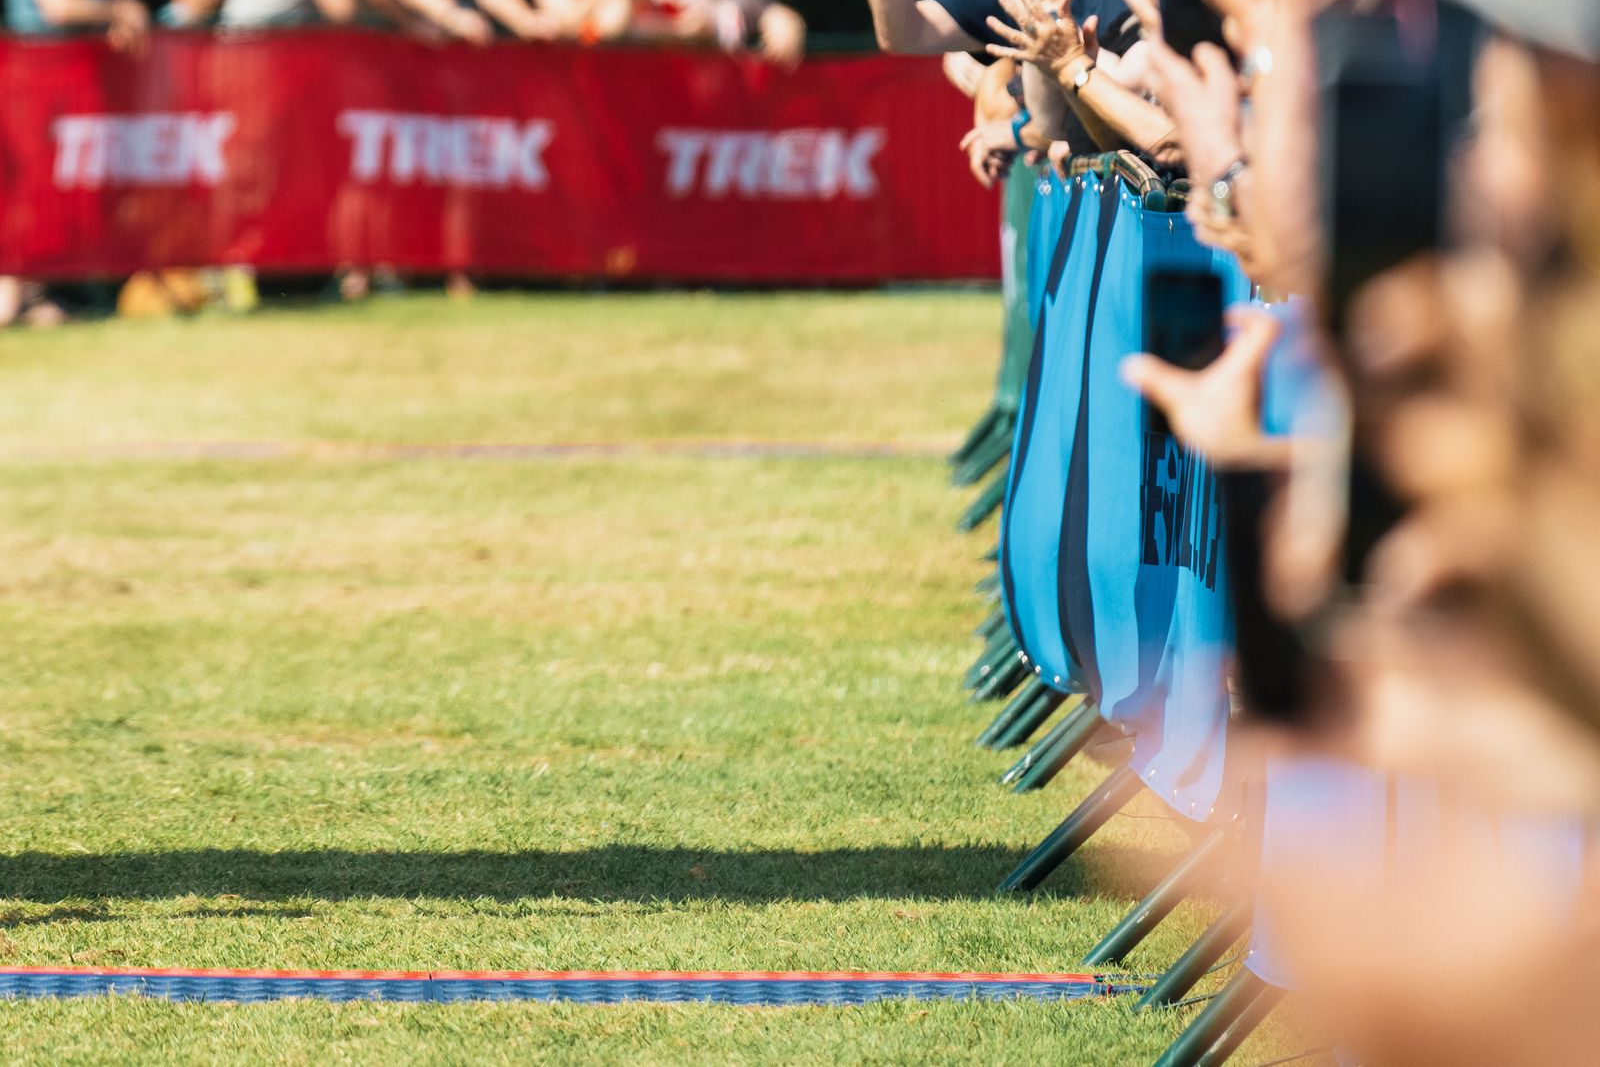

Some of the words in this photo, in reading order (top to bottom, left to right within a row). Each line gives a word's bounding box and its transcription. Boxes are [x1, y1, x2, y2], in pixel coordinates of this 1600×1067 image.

[52, 112, 233, 189] TREK
[338, 110, 553, 190] TREK
[656, 128, 886, 198] TREK
